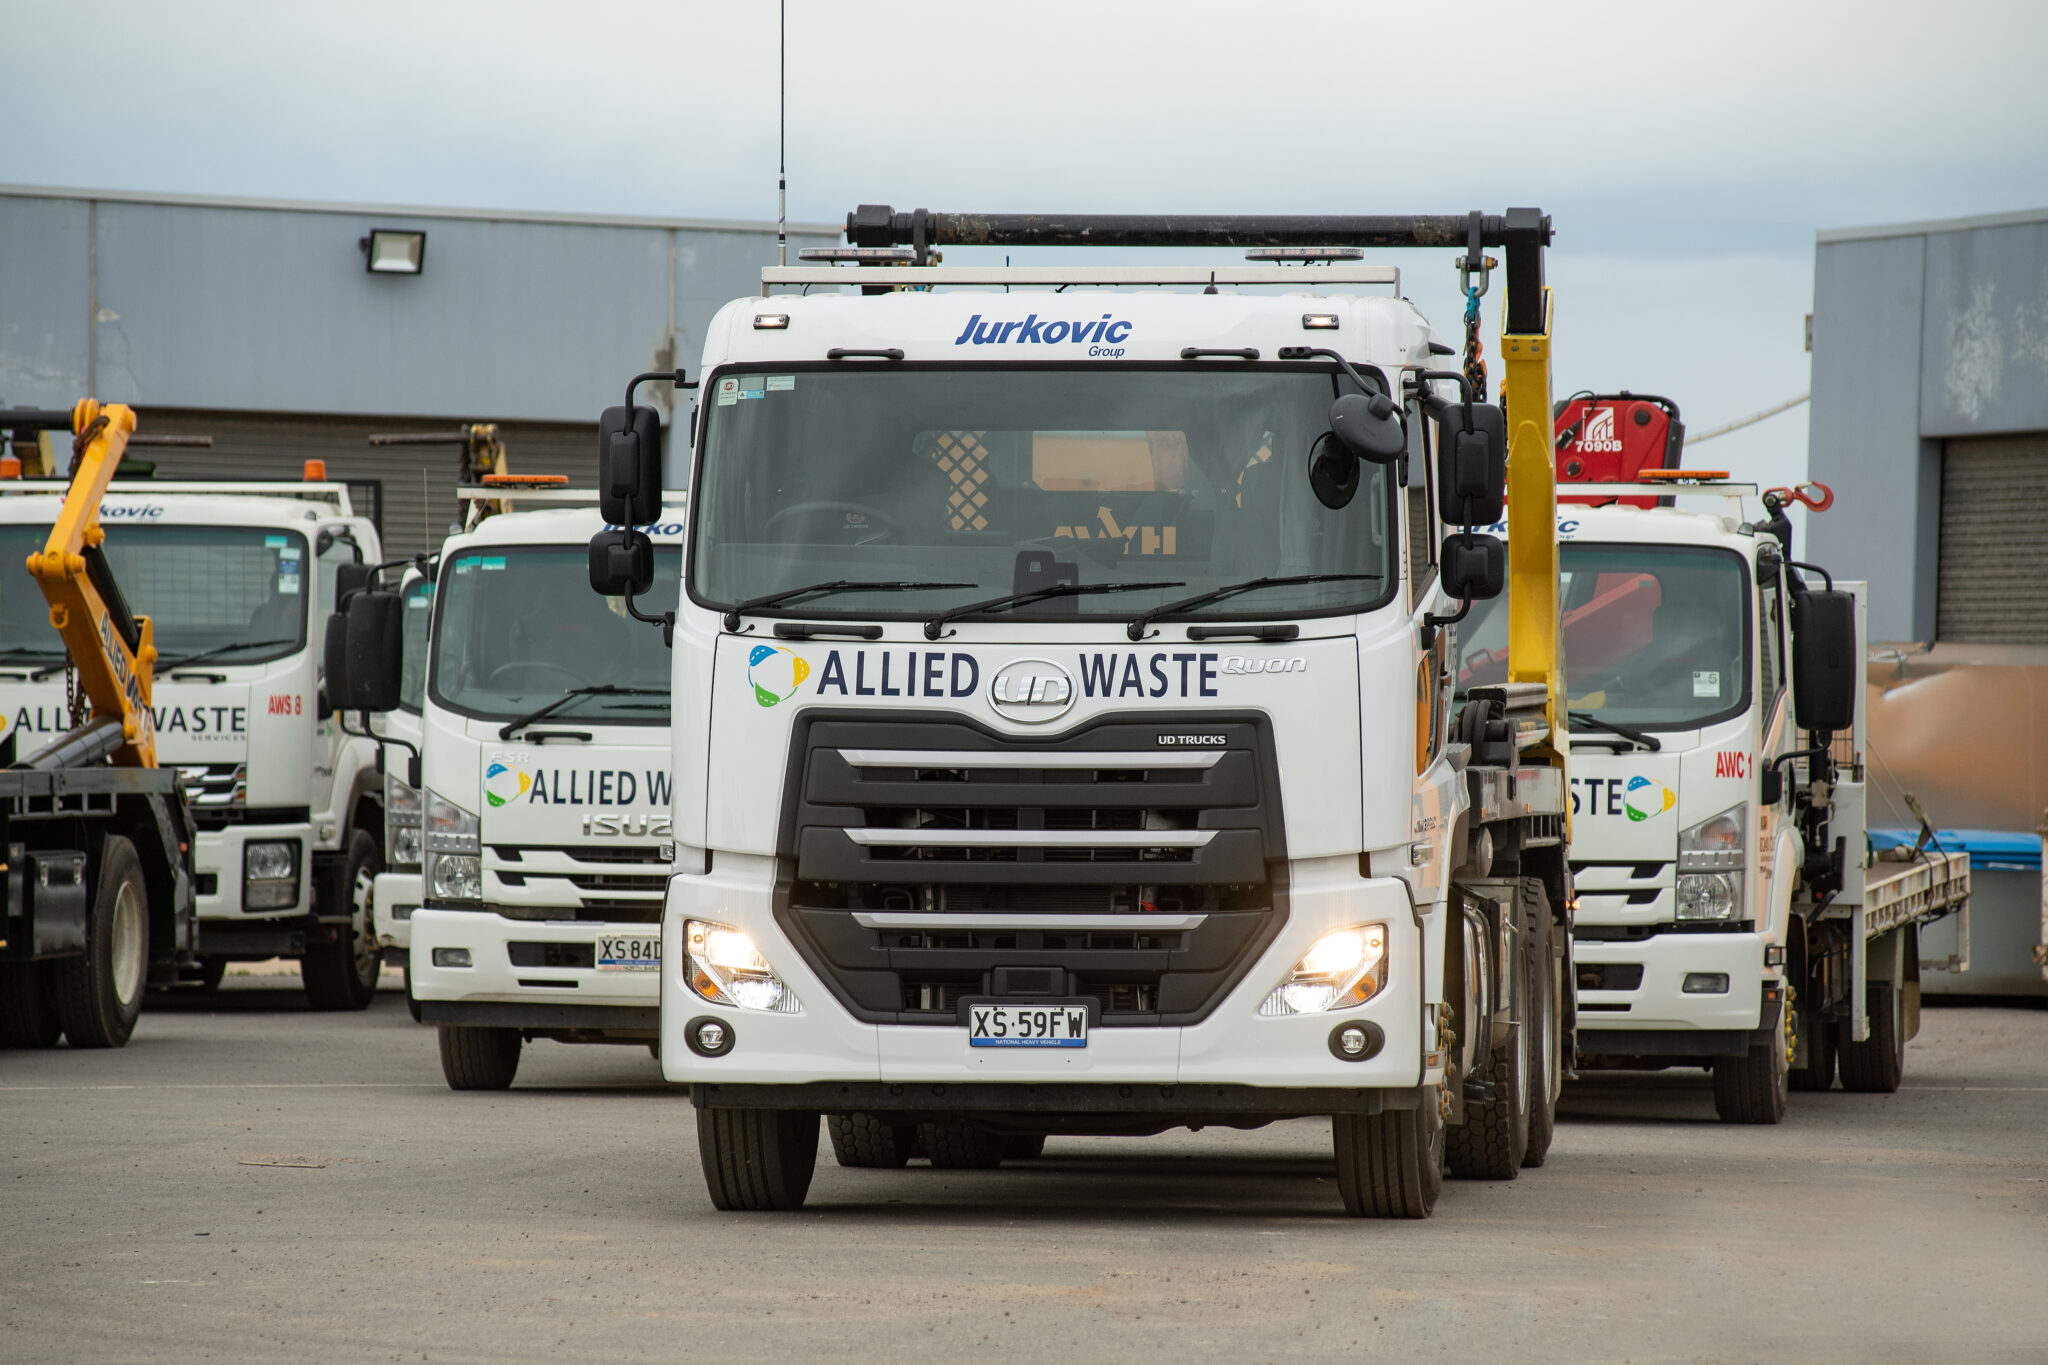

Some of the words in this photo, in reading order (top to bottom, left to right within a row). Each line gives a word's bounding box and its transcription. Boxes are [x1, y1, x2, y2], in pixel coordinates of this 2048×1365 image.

[955, 314, 1132, 345] Jurkovic
[1088, 346, 1125, 359] Group
[1575, 440, 1622, 453] 7090B
[100, 504, 164, 517] kovic
[816, 650, 979, 697] ALLIED
[1079, 653, 1218, 697] WASTE
[1221, 655, 1308, 675] Quon
[267, 694, 292, 716] AWS
[294, 694, 302, 716] 8
[191, 734, 246, 742] SERVICES
[1158, 735, 1176, 745] UD
[1177, 735, 1226, 745] TRUCKS
[1715, 751, 1745, 779] AWC
[1748, 752, 1753, 779] 1
[529, 769, 637, 806] ALLIED
[1571, 778, 1623, 816] STE
[583, 813, 672, 837] ISUZ
